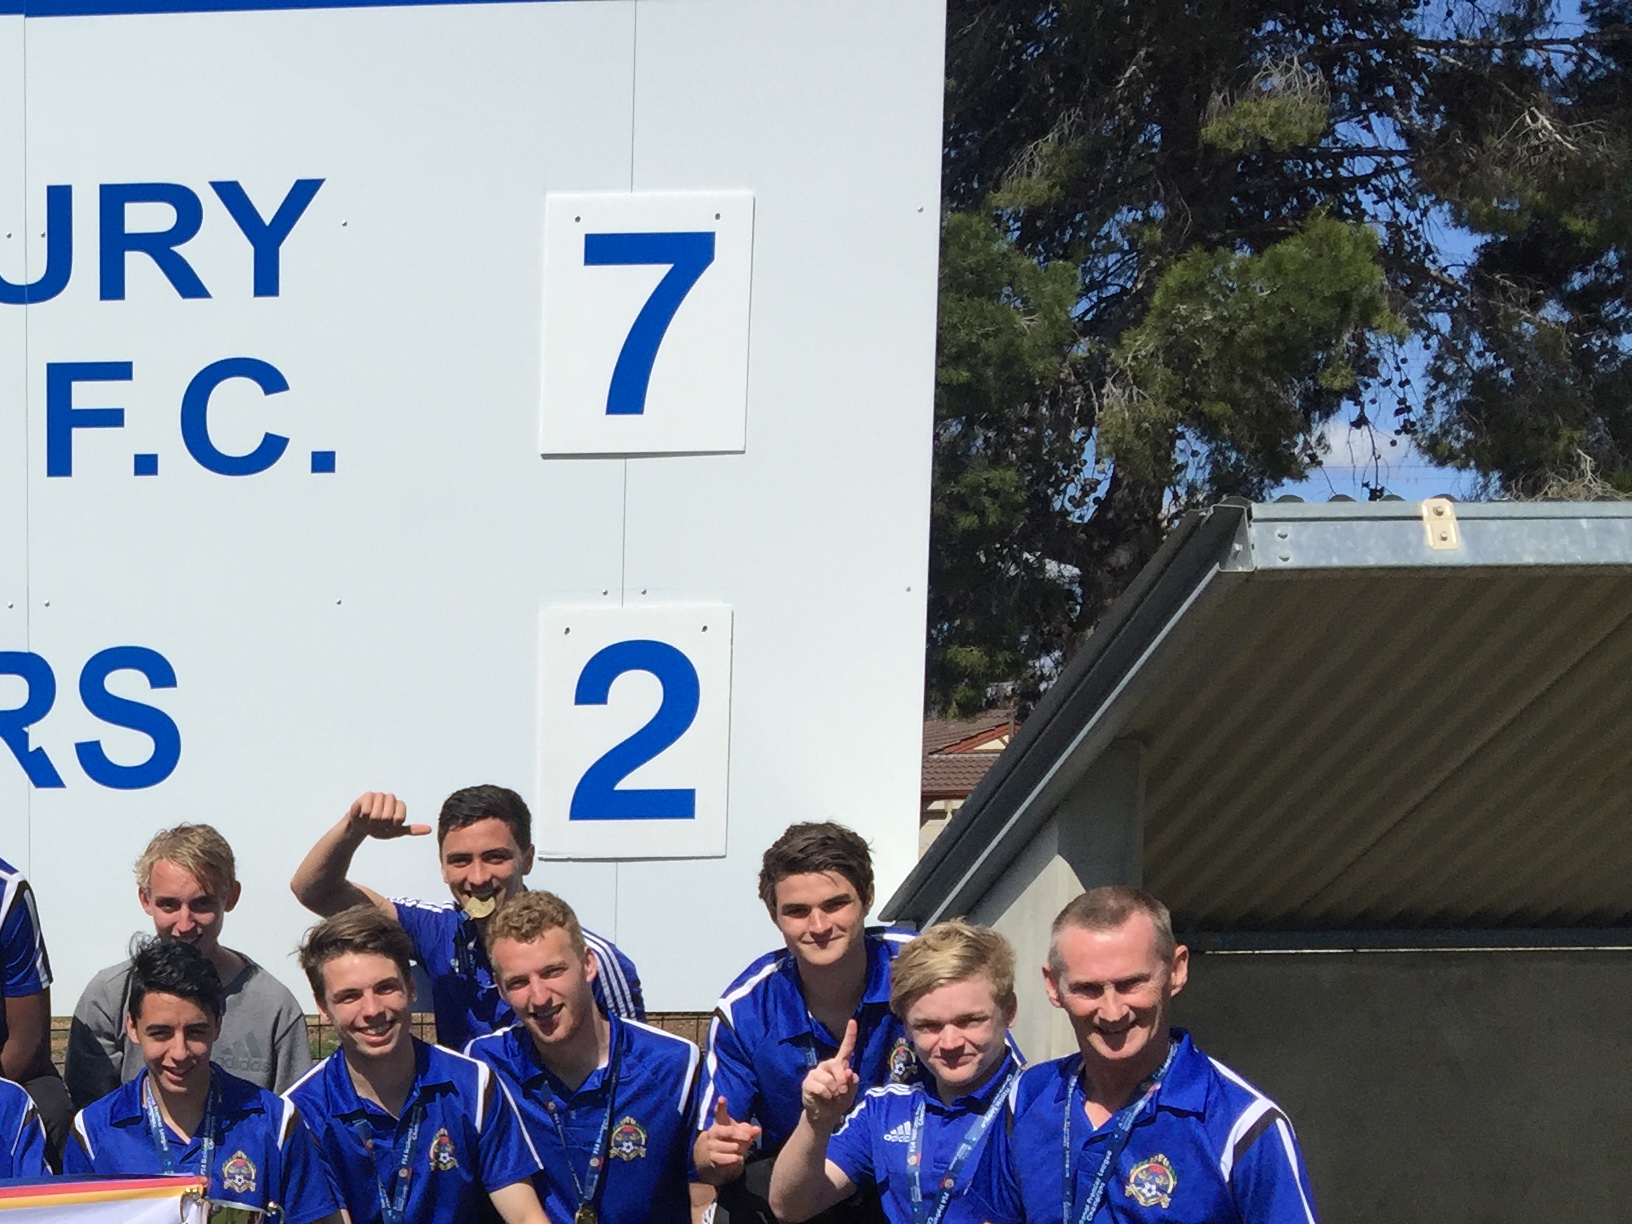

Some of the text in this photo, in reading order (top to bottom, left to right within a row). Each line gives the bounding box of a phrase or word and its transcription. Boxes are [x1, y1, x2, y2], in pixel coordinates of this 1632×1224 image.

[584, 231, 715, 415] 7
[46, 357, 336, 478] F.C.
[569, 639, 700, 821] 2
[1084, 1177, 1102, 1204] Premier
[1096, 1149, 1113, 1177] League
